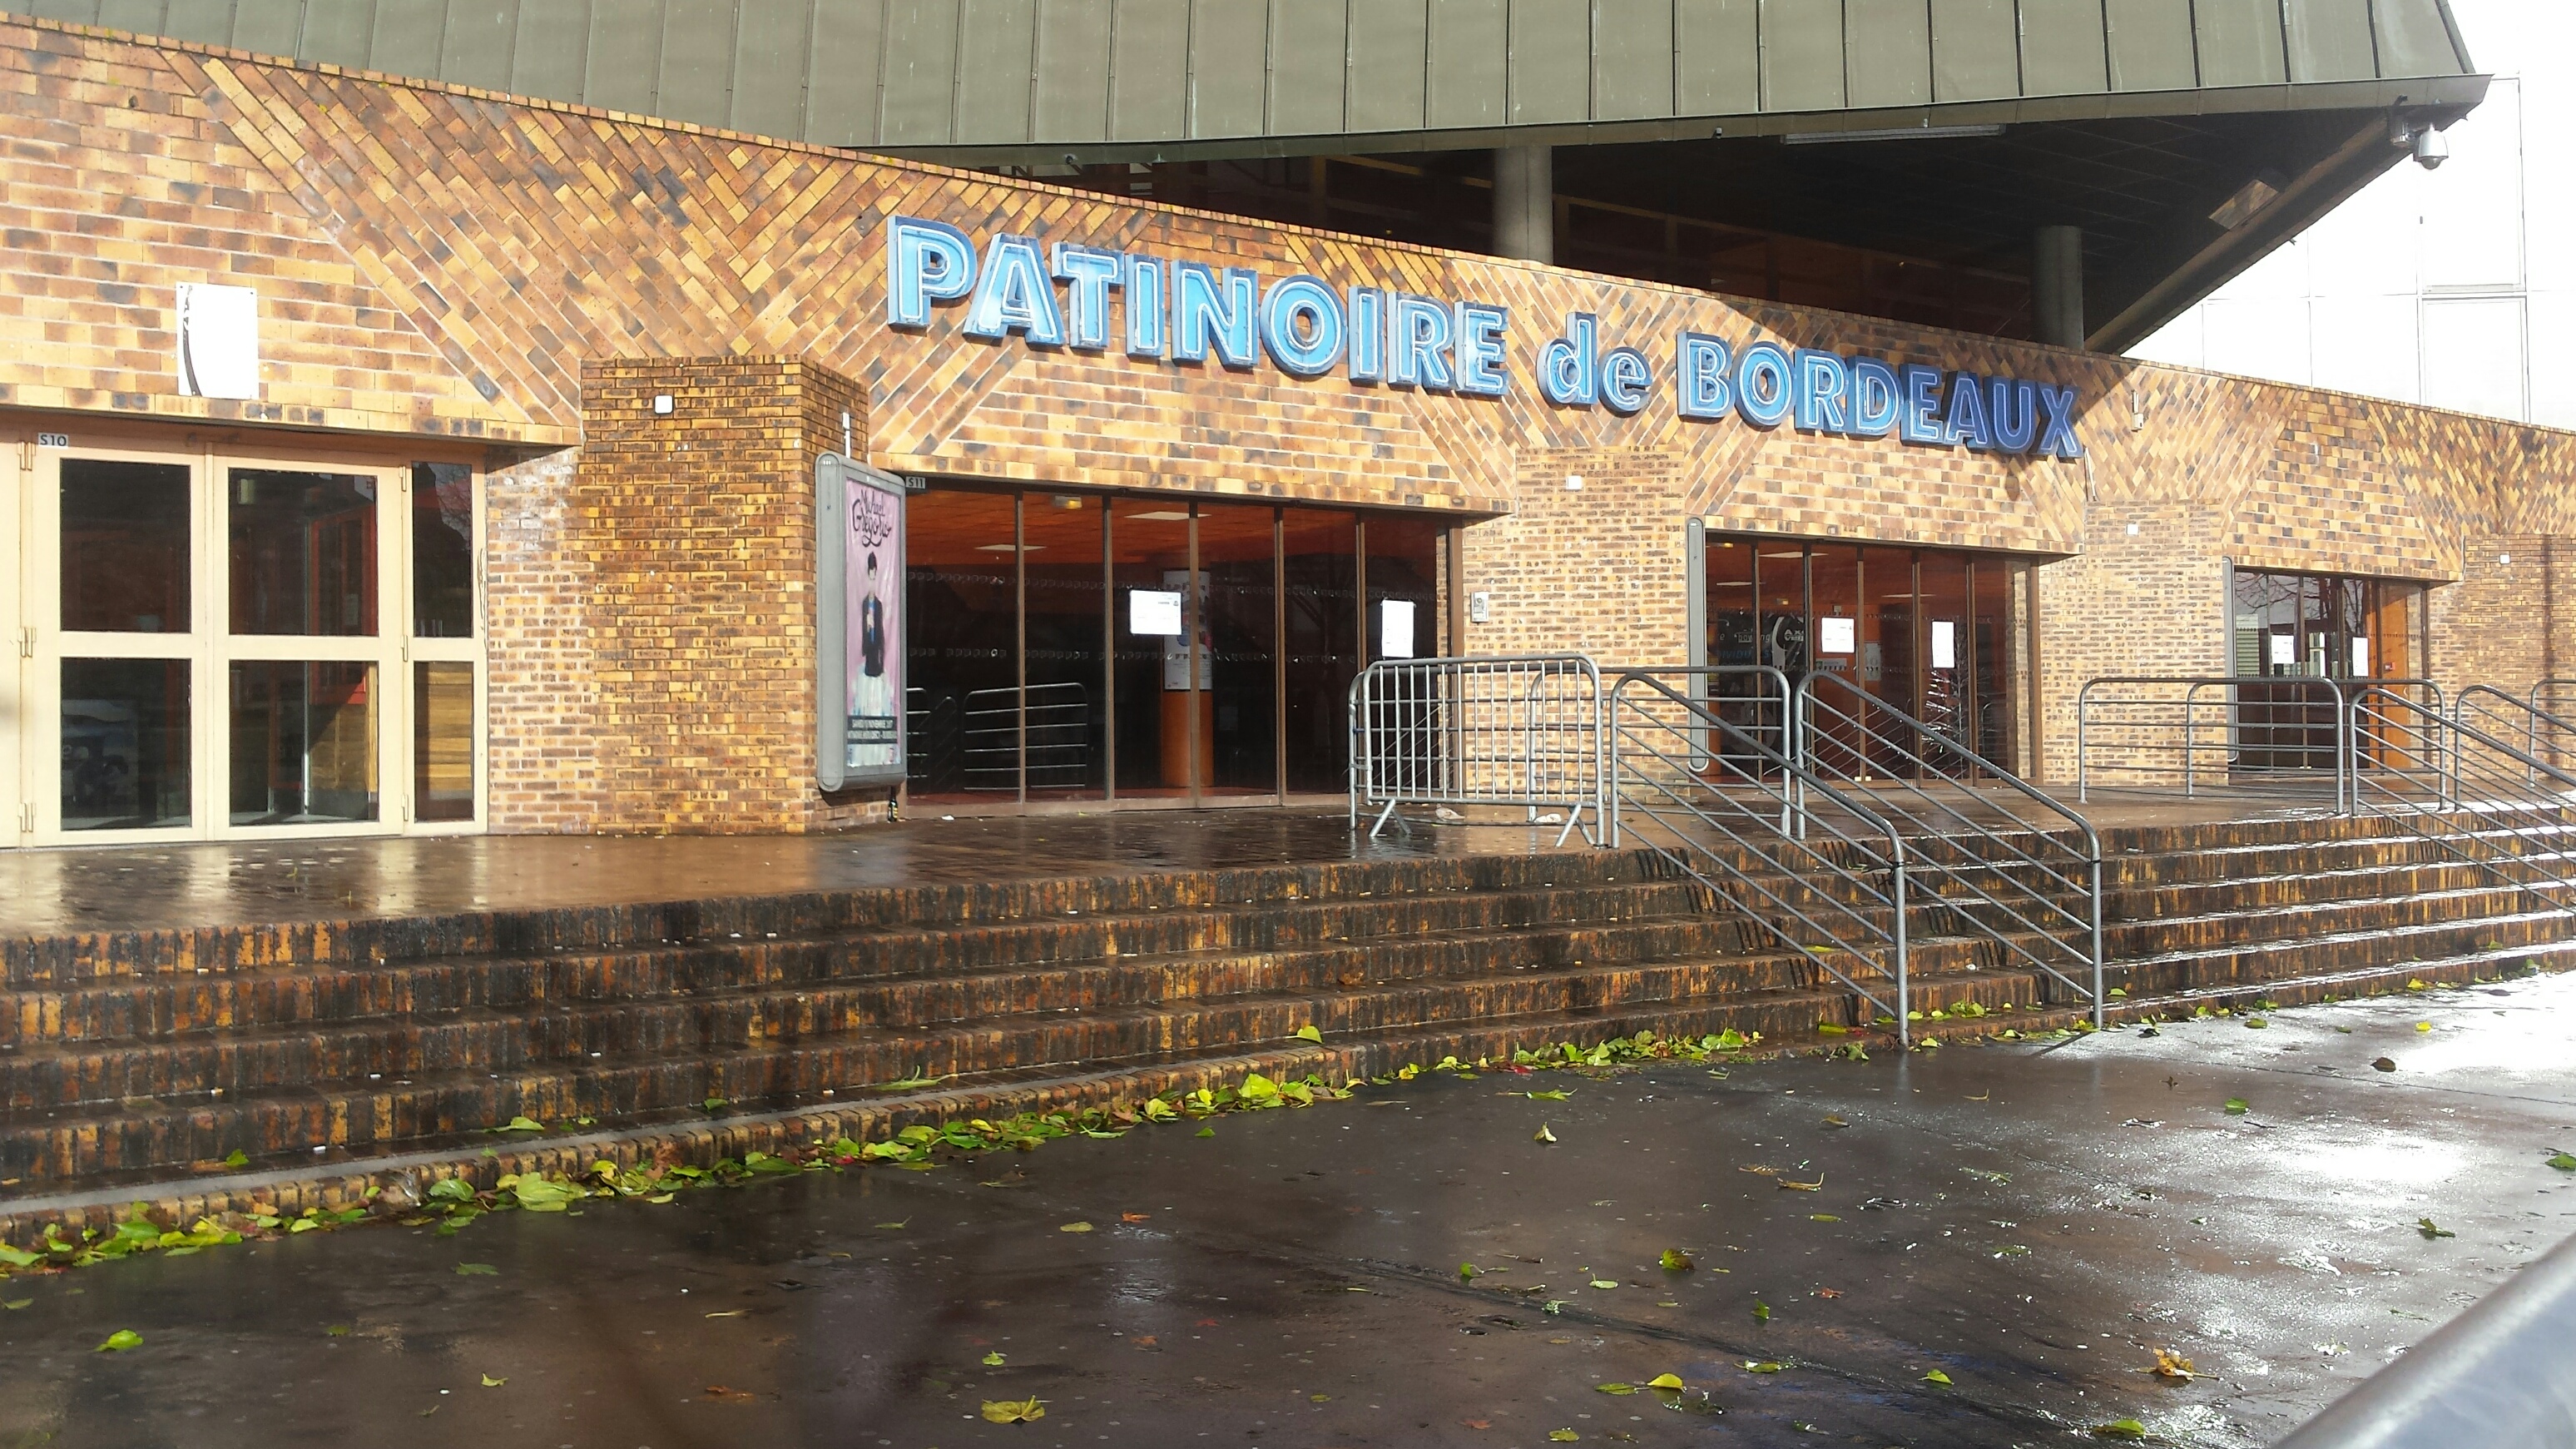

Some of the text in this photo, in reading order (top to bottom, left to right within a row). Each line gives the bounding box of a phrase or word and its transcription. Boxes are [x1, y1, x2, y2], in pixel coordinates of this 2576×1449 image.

[887, 215, 2082, 459] PATINOIRE de BORDEAUX
[40, 434, 67, 446] S10
[908, 477, 924, 488] S11
